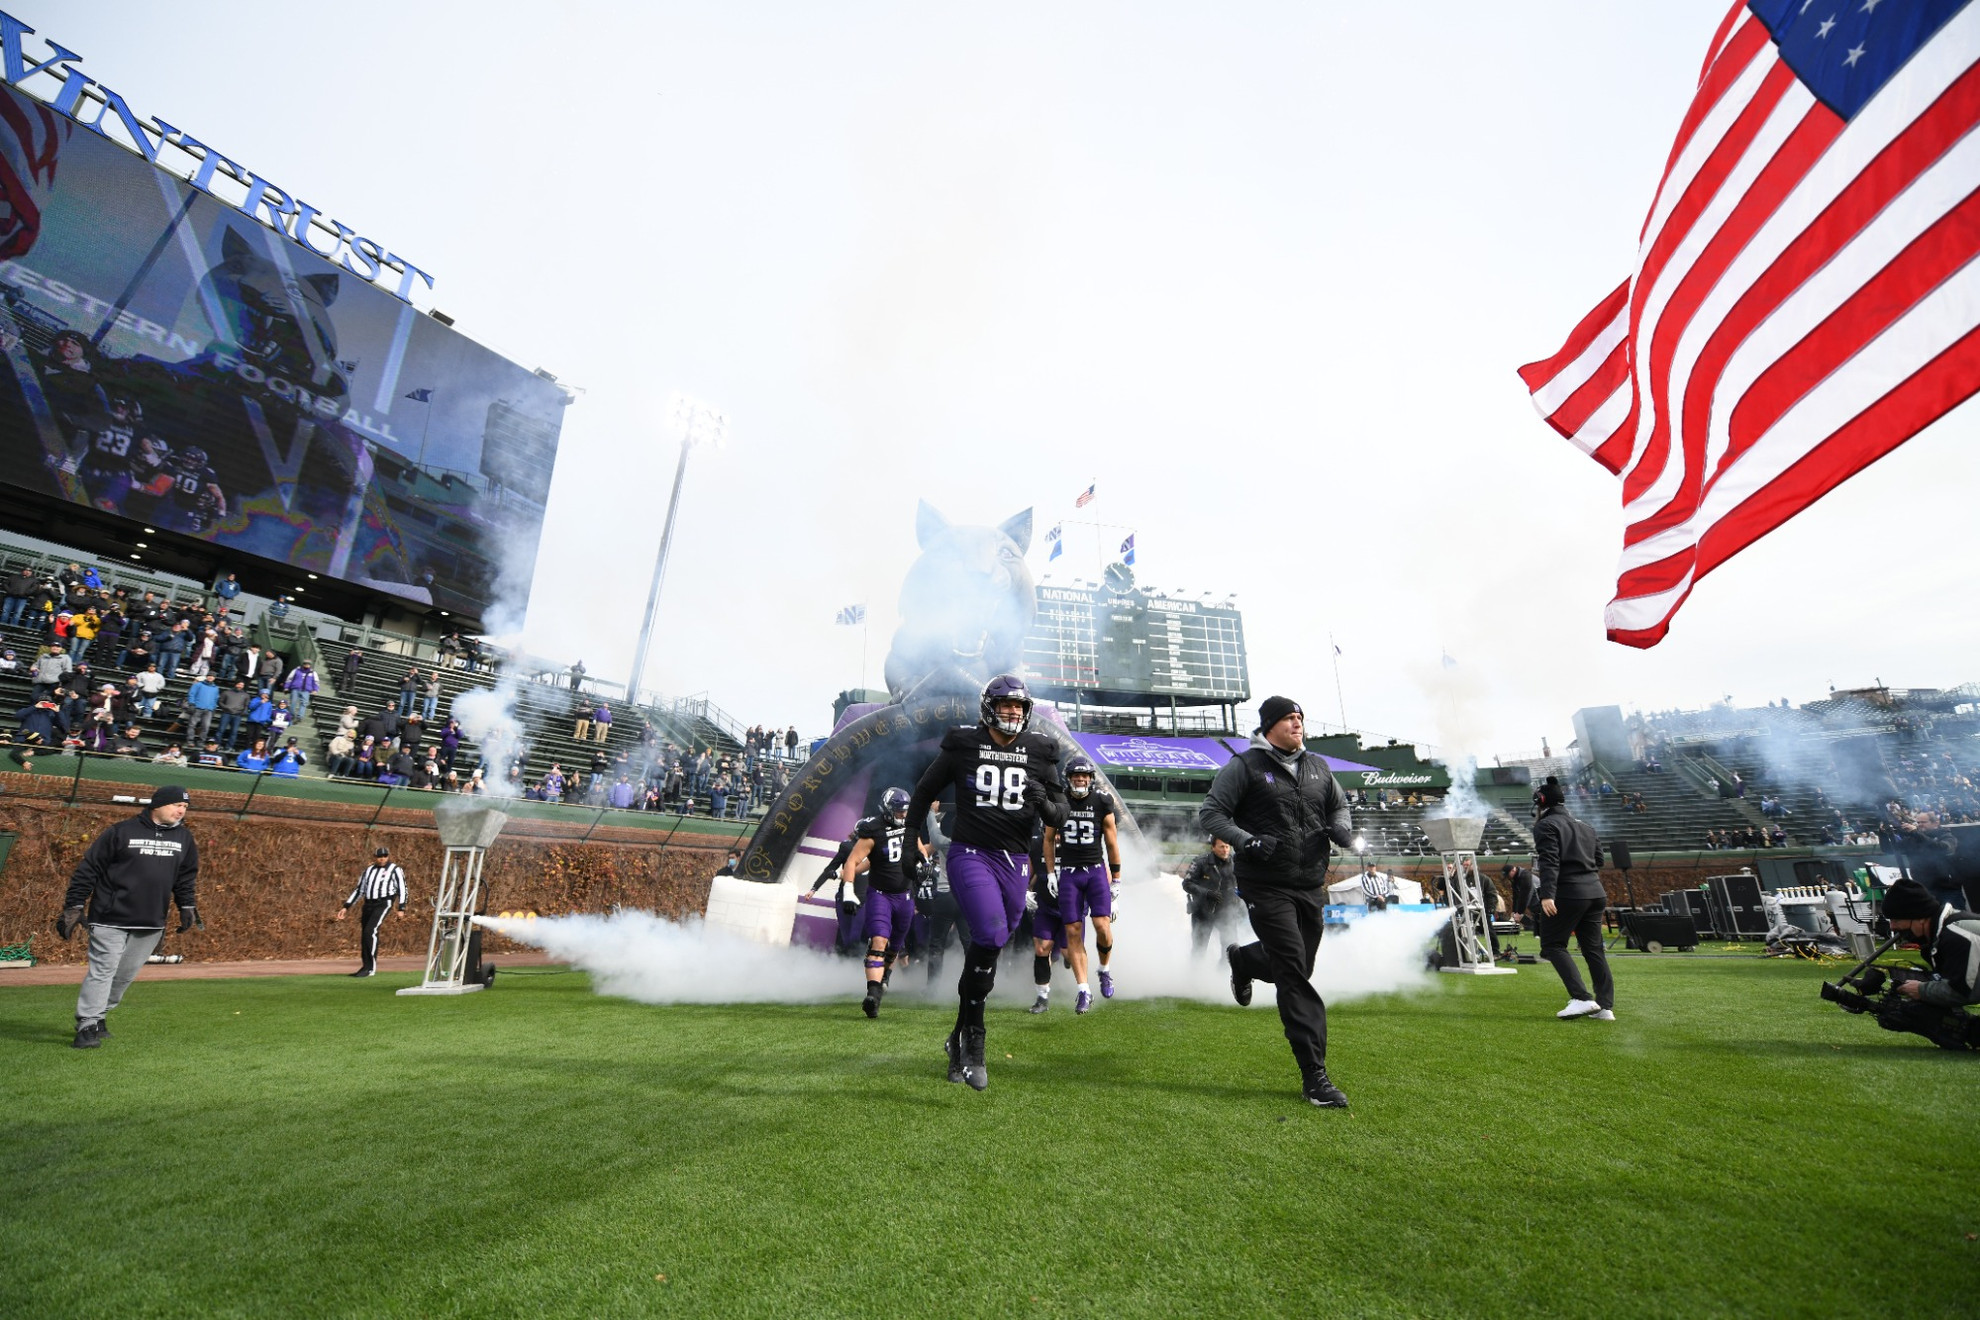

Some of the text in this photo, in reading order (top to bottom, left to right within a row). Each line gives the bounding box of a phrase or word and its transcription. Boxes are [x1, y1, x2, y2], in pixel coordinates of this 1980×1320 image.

[0, 260, 197, 357] ESTERN
[95, 430, 132, 457] 23
[1042, 588, 1095, 603] NATIONAL
[1107, 597, 1135, 607] UMPIRES
[1147, 599, 1196, 613] AMERICAN
[979, 750, 1028, 764] NORTHWESTERN
[1104, 749, 1208, 764] WILDCATS
[772, 703, 969, 835] NORTHWESTER
[1361, 771, 1433, 786] Budweiser
[975, 764, 1027, 811] 98
[1063, 819, 1095, 845] 23
[128, 839, 182, 849] NORTHWESTERN
[139, 848, 174, 857] FOOTBALL
